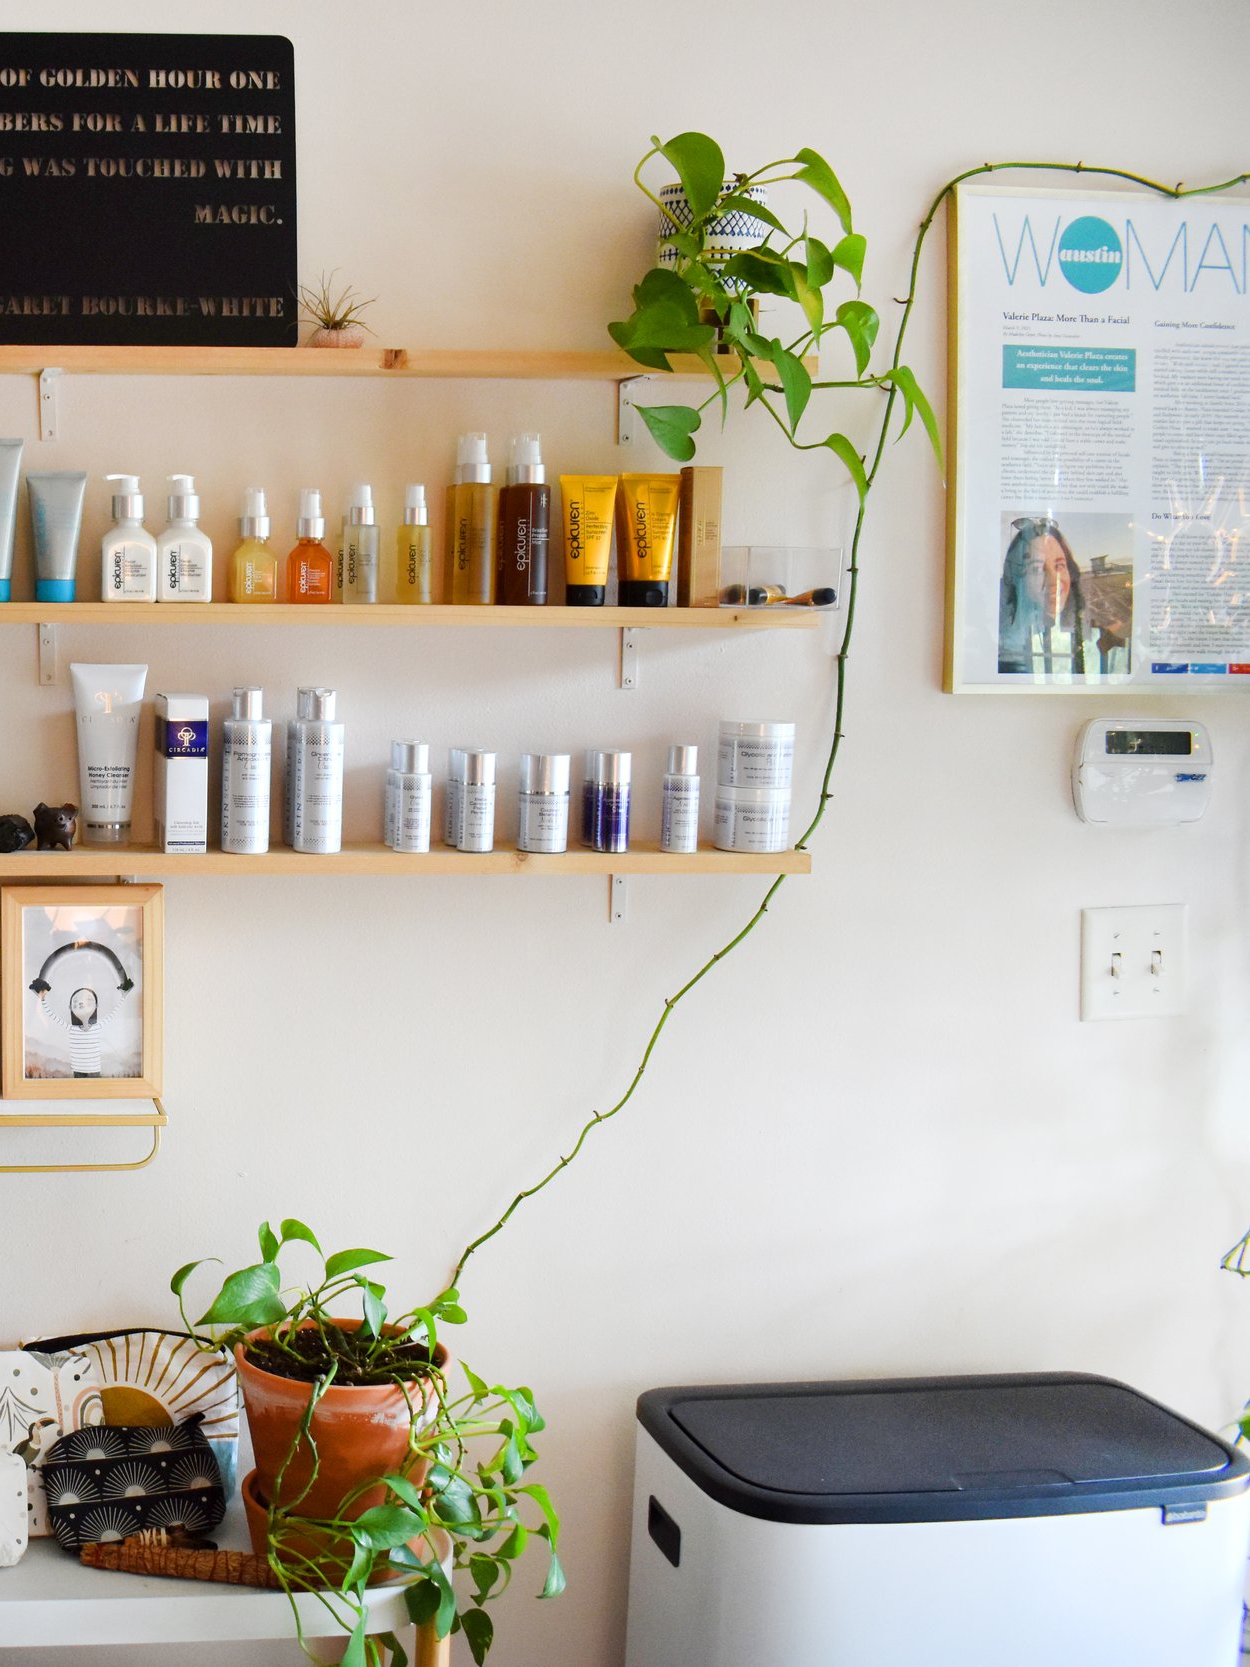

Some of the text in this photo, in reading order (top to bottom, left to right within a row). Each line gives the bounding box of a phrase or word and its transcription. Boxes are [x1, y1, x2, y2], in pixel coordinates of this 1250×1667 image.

[0, 69, 32, 87] OF
[40, 69, 139, 88] GOLDEN
[149, 70, 221, 88] HOUR
[230, 71, 280, 90] ONE
[73, 113, 123, 132] FOR
[131, 114, 146, 132] A
[155, 114, 210, 133] LIFE
[218, 115, 281, 134] TIME
[22, 157, 76, 177] WAS
[83, 158, 206, 178] TOUCHED
[214, 159, 282, 179] WITH
[194, 205, 282, 224] MAGIC.
[993, 213, 1250, 294] WOMA
[1061, 245, 1122, 264] austin
[81, 296, 283, 317] BOURKE-WHITE
[1003, 312, 1029, 321] Valerie
[1031, 313, 1054, 321] Plaza:
[1056, 314, 1077, 322] More
[1079, 315, 1099, 323] Than
[1108, 316, 1130, 324] Facial
[1154, 321, 1180, 330] Gaining
[1200, 322, 1235, 330] Confidence
[1016, 350, 1058, 358] Aesthetician
[1060, 351, 1083, 359] Valerie
[458, 518, 470, 571] epicuren
[514, 518, 530, 571] epicuren
[568, 500, 584, 559] epicuren
[634, 501, 652, 559] epicuren
[114, 551, 127, 590] epicuren
[169, 550, 181, 589] epicuren
[300, 561, 310, 594] epicuren
[348, 544, 358, 585] epicuren
[407, 544, 418, 585] epicuren
